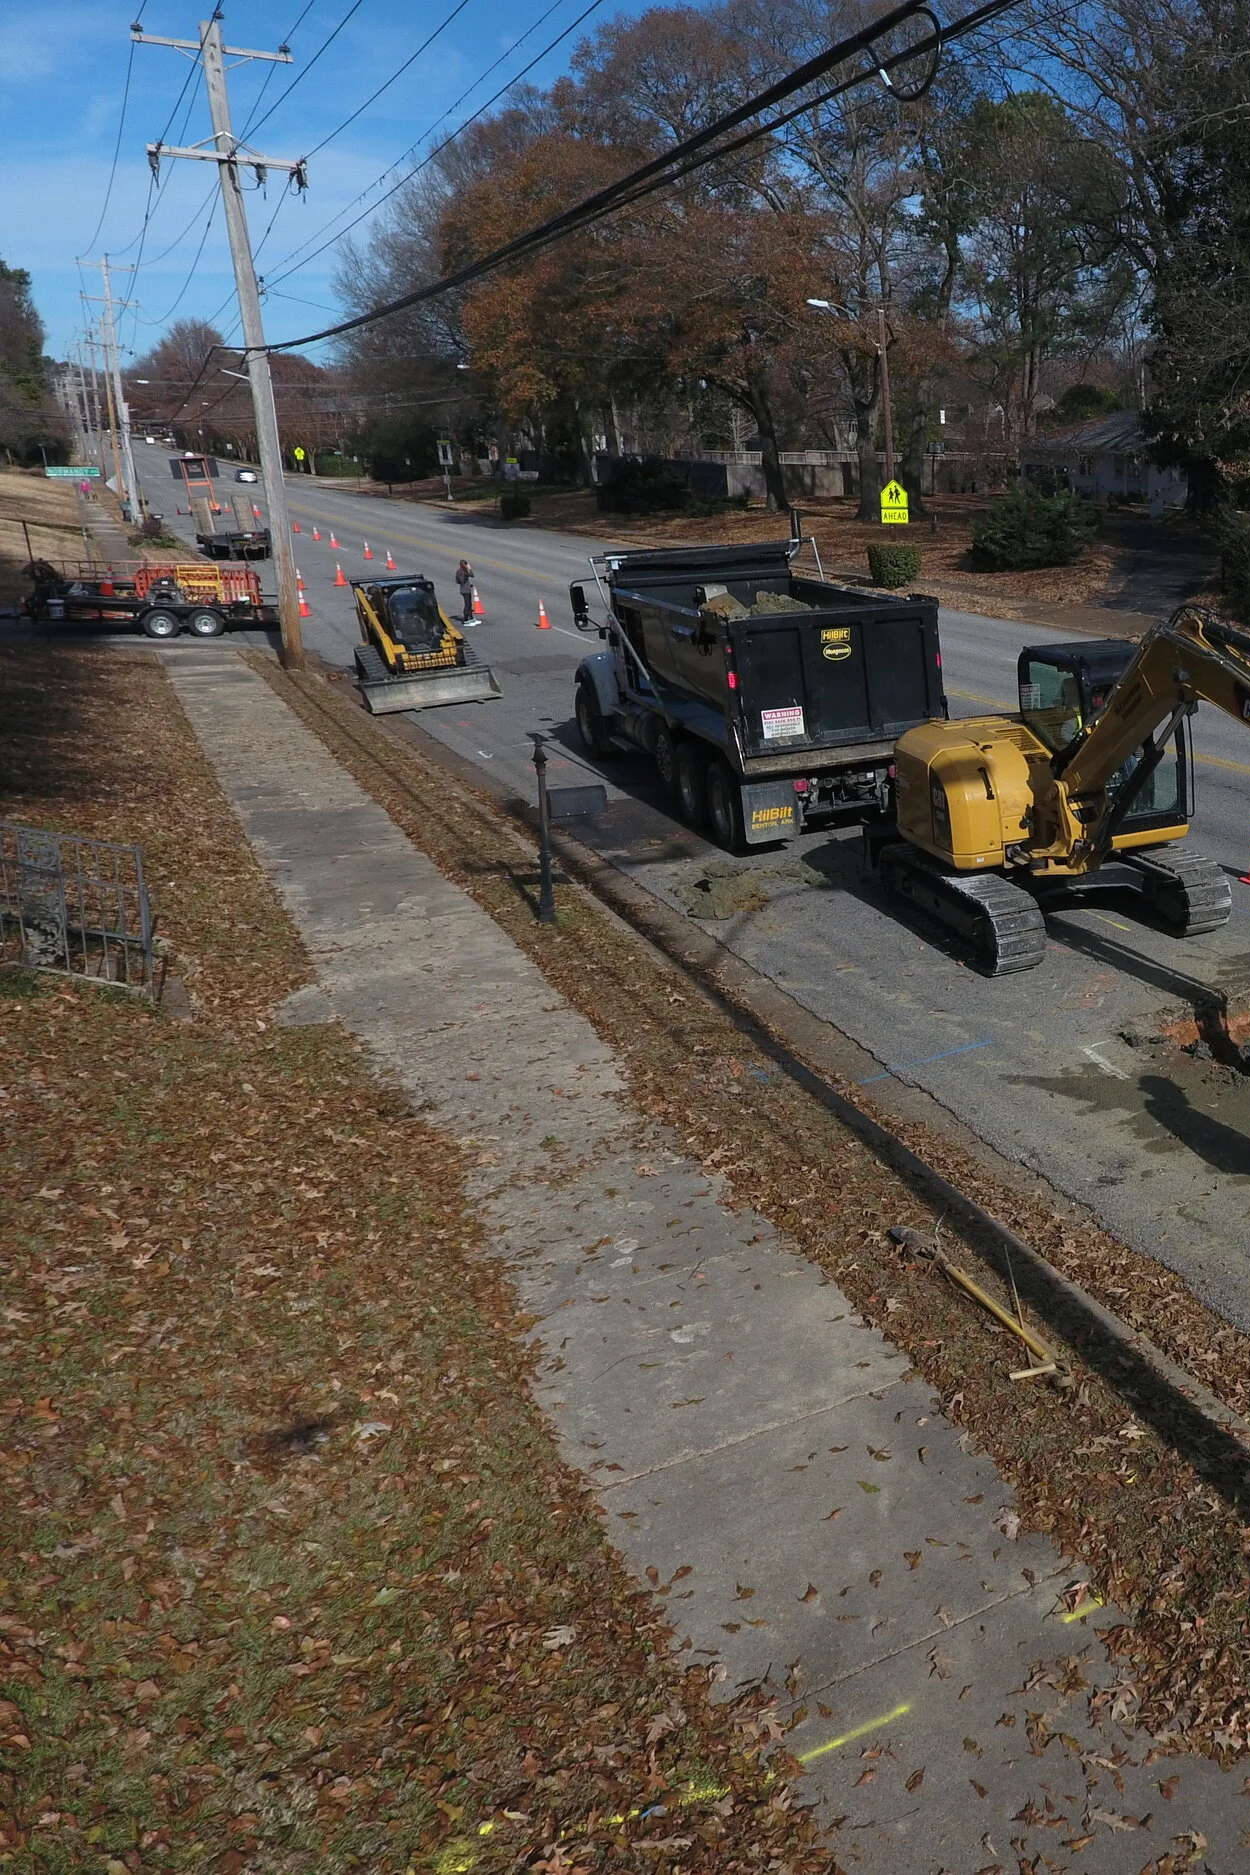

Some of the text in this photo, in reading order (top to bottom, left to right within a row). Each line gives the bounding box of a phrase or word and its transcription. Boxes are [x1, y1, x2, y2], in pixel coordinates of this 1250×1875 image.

[884, 511, 907, 521] AHEAD
[764, 709, 800, 719] WARNING
[752, 806, 793, 823] HilBilt
